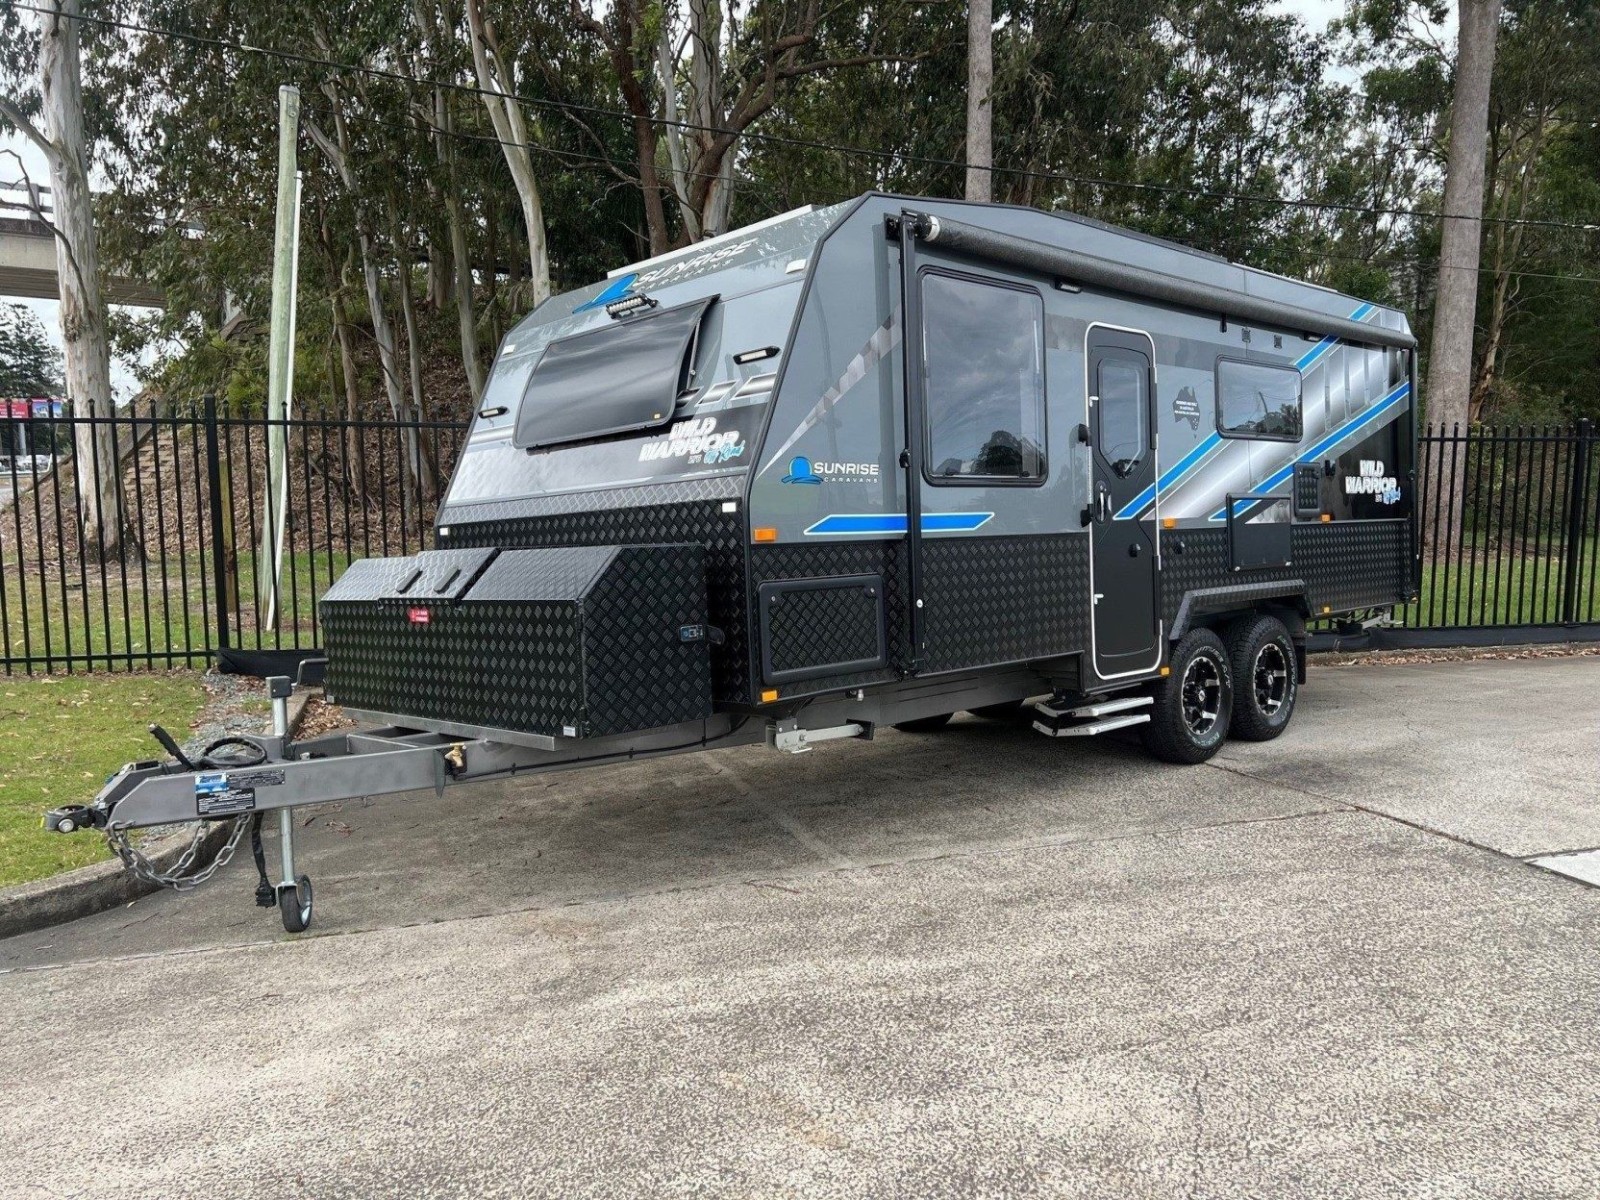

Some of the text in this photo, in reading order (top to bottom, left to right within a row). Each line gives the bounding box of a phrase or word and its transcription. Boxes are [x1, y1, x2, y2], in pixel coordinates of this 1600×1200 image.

[633, 239, 757, 287] SUNRISE
[668, 417, 717, 440] WILD
[814, 461, 880, 476] SUNRISE
[1359, 459, 1385, 477] WILD
[823, 476, 879, 484] CARAVANS
[1345, 476, 1397, 495] WARRIOR
